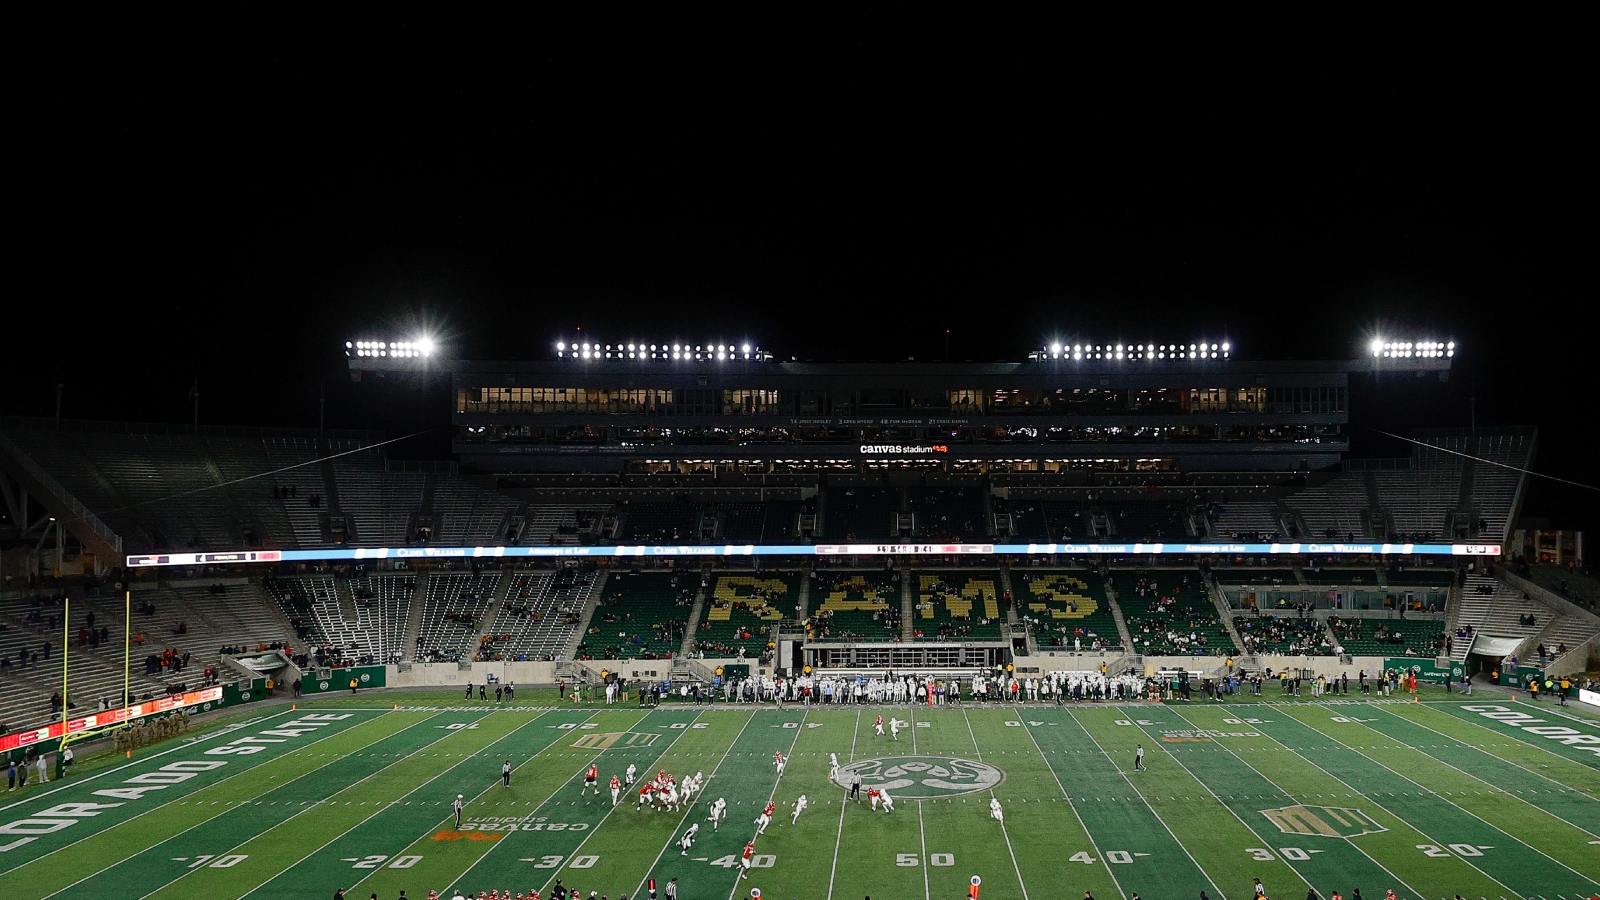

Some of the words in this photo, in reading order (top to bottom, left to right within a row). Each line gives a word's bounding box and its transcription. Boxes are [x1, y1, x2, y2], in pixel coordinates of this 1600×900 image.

[860, 445, 902, 453] canvas
[903, 445, 933, 453] stadium
[708, 575, 1099, 620] RAMS
[203, 713, 354, 755] STATE
[457, 823, 589, 831] canvas
[1245, 847, 1311, 861] 30
[1415, 843, 1485, 857] 20
[184, 855, 249, 868] 10
[351, 855, 423, 868] 20
[534, 855, 599, 868] 30
[710, 854, 777, 868] 40
[895, 853, 955, 867] 50
[1068, 851, 1134, 864] 40
